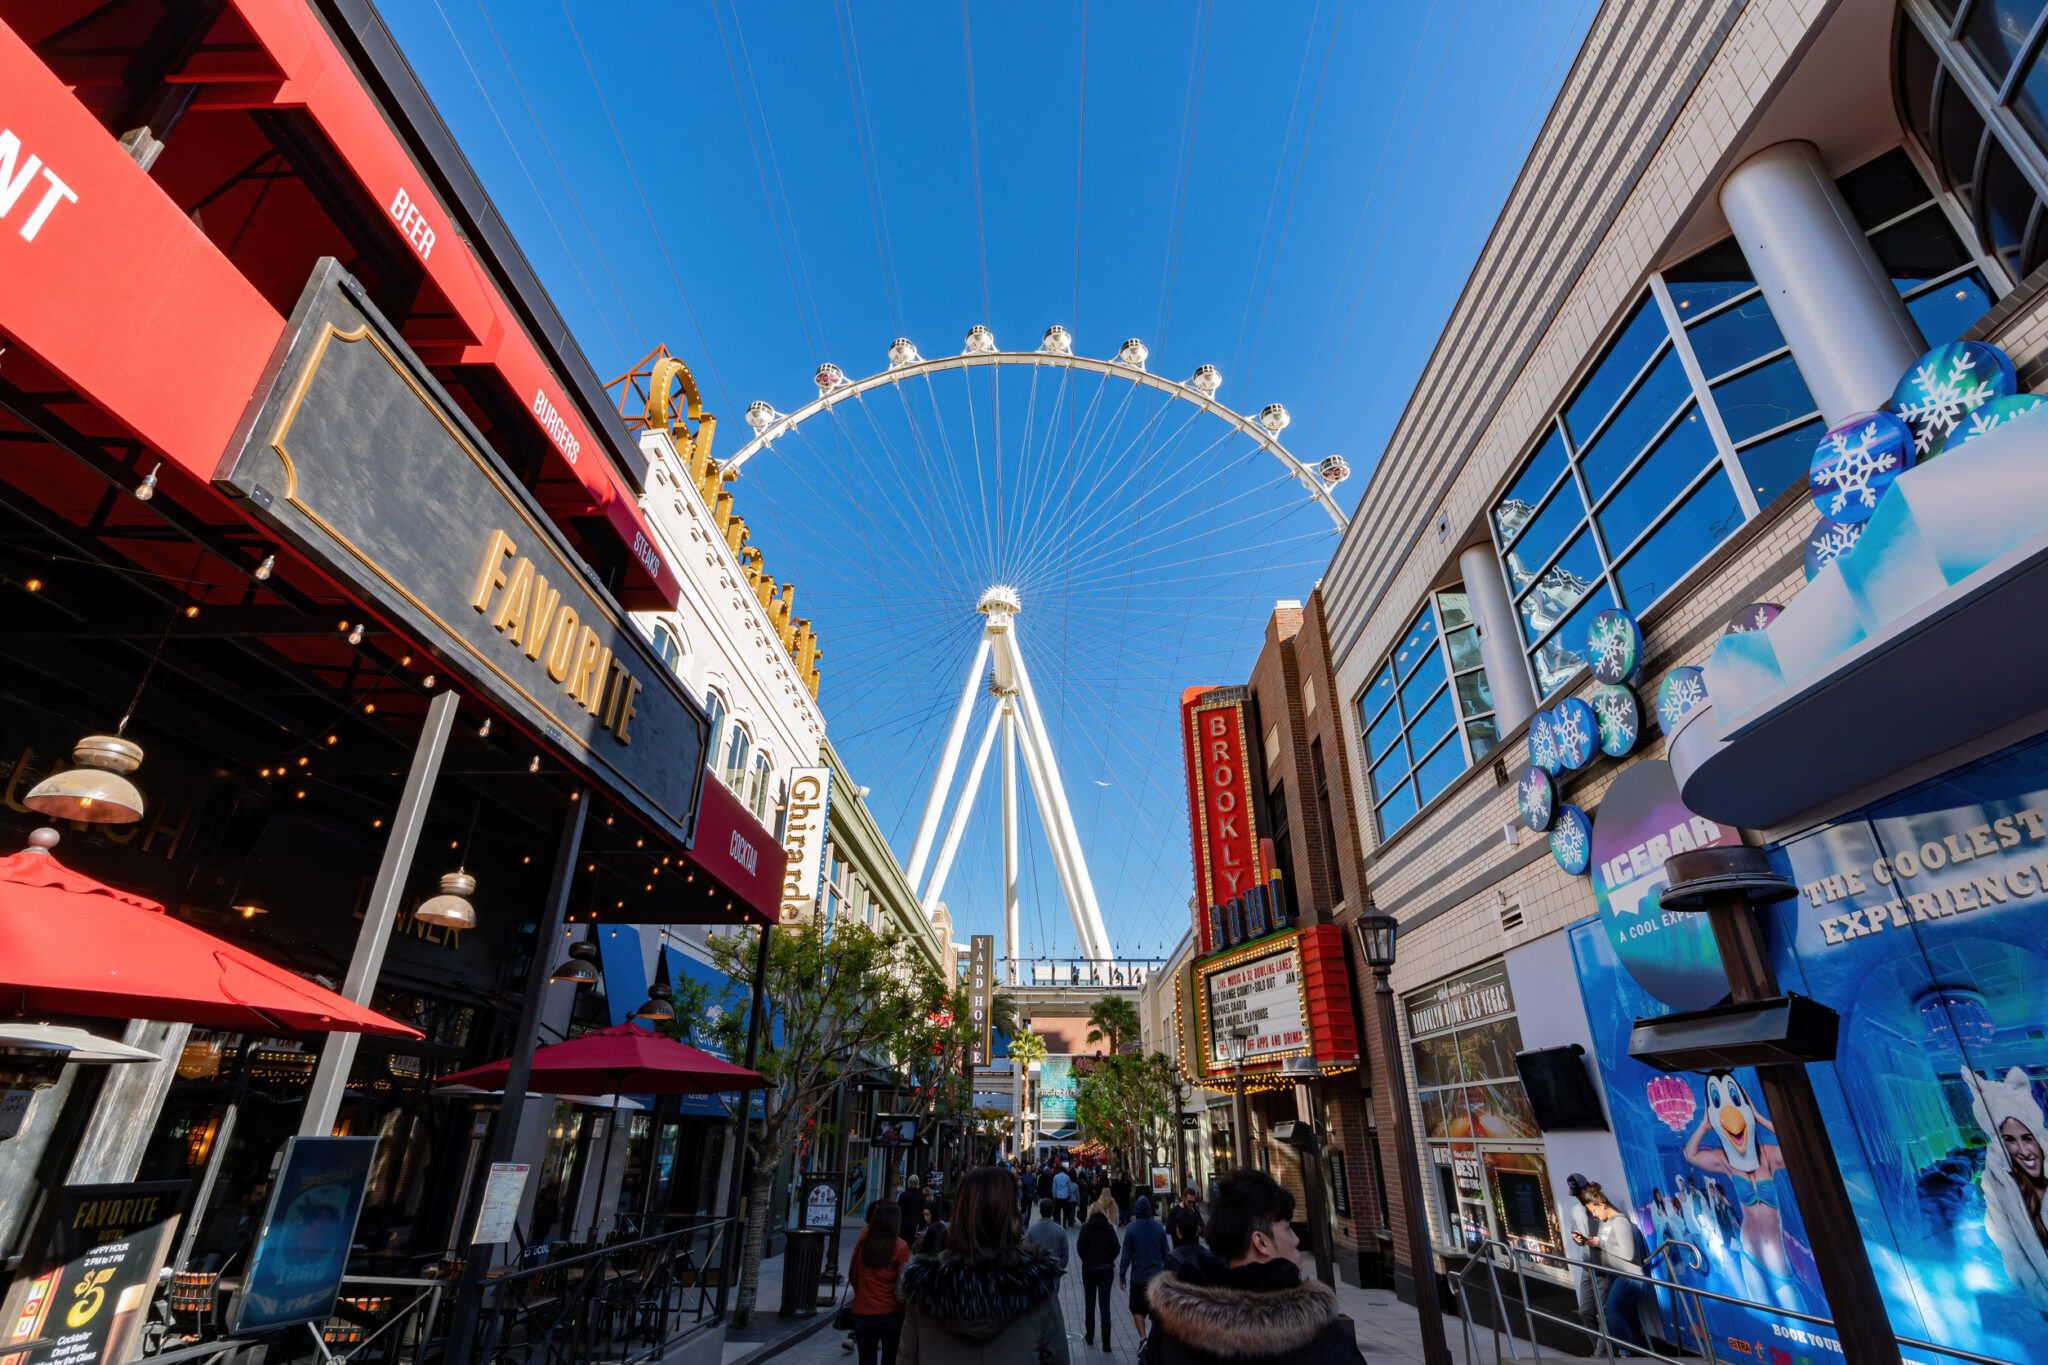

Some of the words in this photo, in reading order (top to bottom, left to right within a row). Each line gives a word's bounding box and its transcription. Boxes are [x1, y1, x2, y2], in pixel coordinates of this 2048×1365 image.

[390, 187, 435, 260] BEER
[533, 389, 580, 464] BURGERS
[633, 531, 660, 579] STEAKS
[473, 529, 643, 747] FAVORITE
[1209, 715, 1243, 894] BROOKLY
[730, 829, 758, 877] COCKTAIL
[779, 775, 821, 922] Ghirarde
[1601, 815, 1721, 889] ICEBAR
[1803, 867, 1867, 908] THE
[1872, 808, 2046, 887] COOLEST
[1209, 878, 1287, 952] BOWL
[1620, 931, 1627, 944] A
[1629, 918, 1660, 939] COOL
[975, 938, 985, 989] YARD
[1217, 977, 1227, 990] LIVE
[1227, 973, 1241, 987] MUSIC
[1254, 963, 1276, 979] BOWLING
[1276, 957, 1293, 973] LANES
[1220, 988, 1236, 1002] ORANGE
[1266, 976, 1276, 990] OUT
[1286, 971, 1296, 985] JAN
[1244, 1007, 1269, 1022] PLAYHOUSE
[1412, 1005, 1445, 1034] BROOKLYN
[1444, 998, 1466, 1026] BOWL
[1465, 992, 1482, 1020] LAS
[1480, 984, 1509, 1015] VEGAS
[1256, 1036, 1269, 1049] APPS
[1271, 1033, 1281, 1047] AND
[1283, 1031, 1303, 1045] DRINKS
[1182, 1117, 1197, 1125] VCA
[1454, 1160, 1479, 1178] BEST
[72, 1197, 160, 1229] FAVORITE
[90, 1257, 101, 1266] PM
[101, 1256, 109, 1265] to
[112, 1254, 125, 1263] PM
[109, 1242, 130, 1253] HOUR
[66, 1268, 117, 1328] $5
[51, 1345, 71, 1358] Draft
[70, 1343, 89, 1353] Beer
[63, 1356, 77, 1365] the
[76, 1351, 97, 1363] Glass
[1771, 1323, 1808, 1344] BOOK
[1806, 1332, 1843, 1353] YOUR
